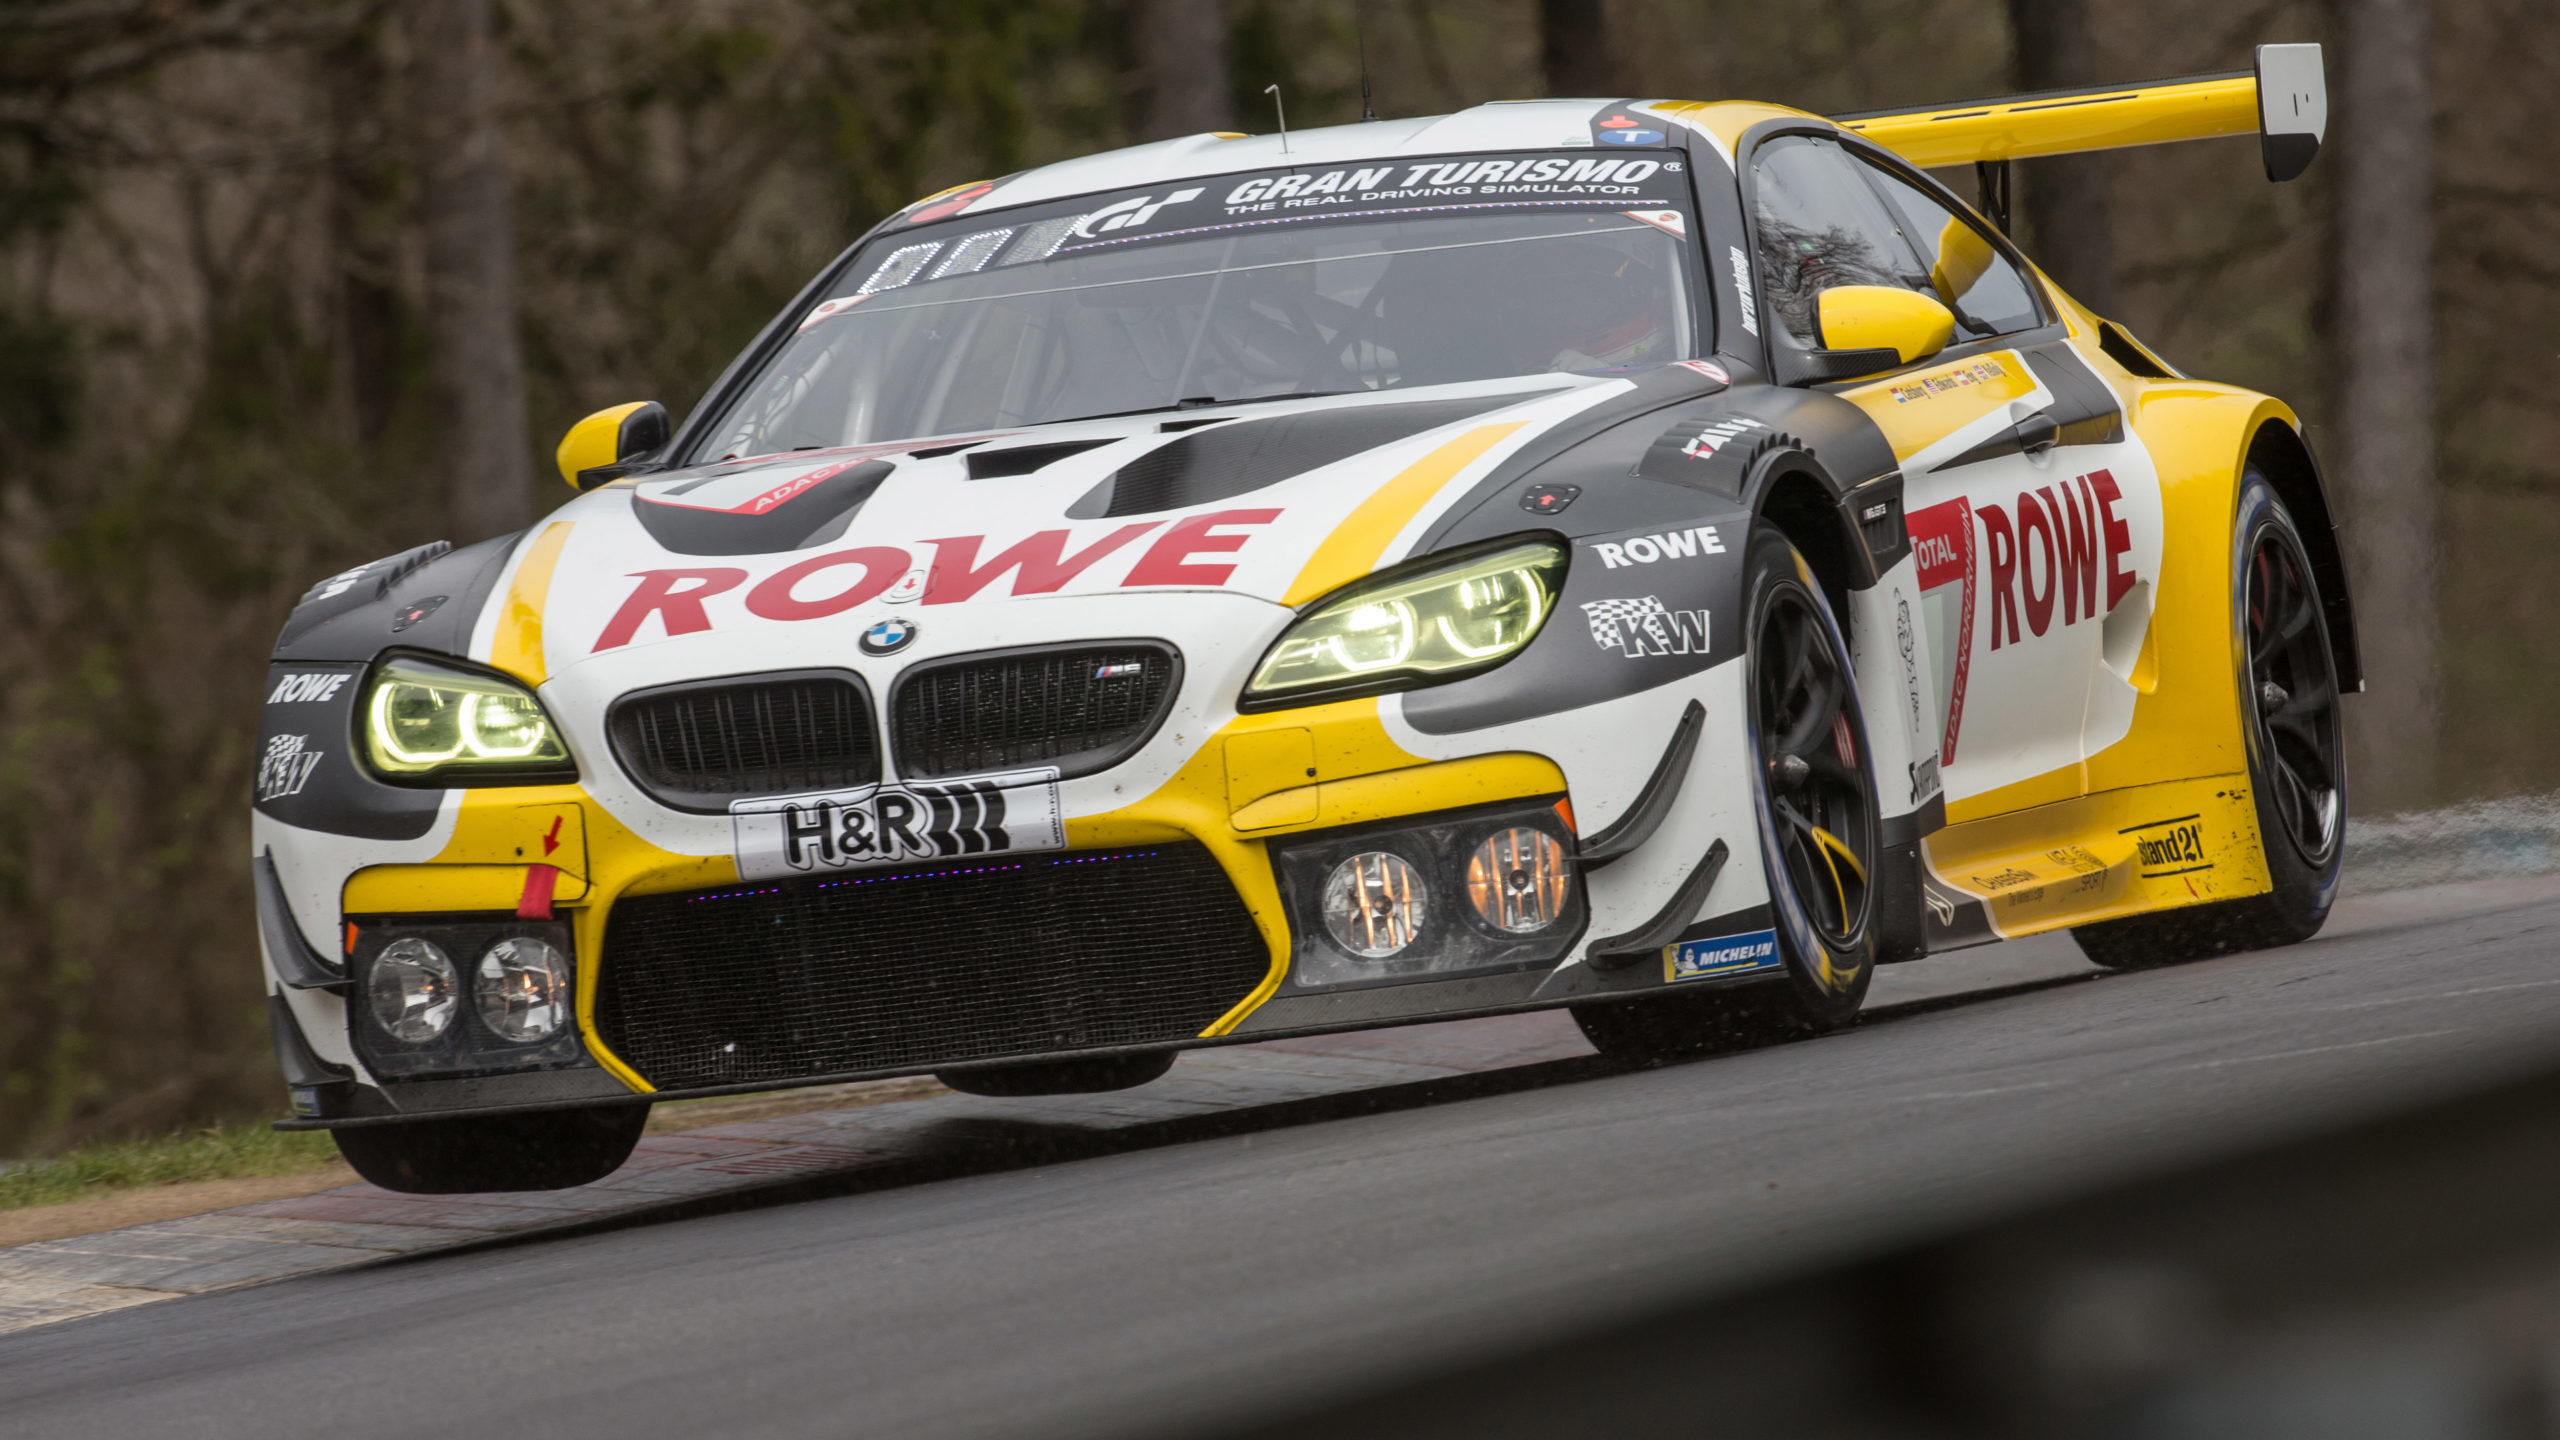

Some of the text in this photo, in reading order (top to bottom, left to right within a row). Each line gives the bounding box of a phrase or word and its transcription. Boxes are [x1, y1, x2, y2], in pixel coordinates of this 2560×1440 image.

[1224, 184, 1641, 215] THE REAL DRIVING SIMULATOR
[1225, 166, 1395, 205] GRAN
[755, 468, 831, 512] ADAC
[1590, 526, 1727, 569] ROWE
[1909, 533, 1957, 572] TOTAL
[1974, 468, 2137, 652] ROWE
[591, 508, 1285, 654] ROWE
[1614, 609, 1711, 658] KW
[1946, 502, 1974, 760] ADAC NORDRHEIN
[266, 674, 352, 705] ROWE
[785, 794, 923, 864] H&R
[1699, 941, 1774, 966] MICHELIN
